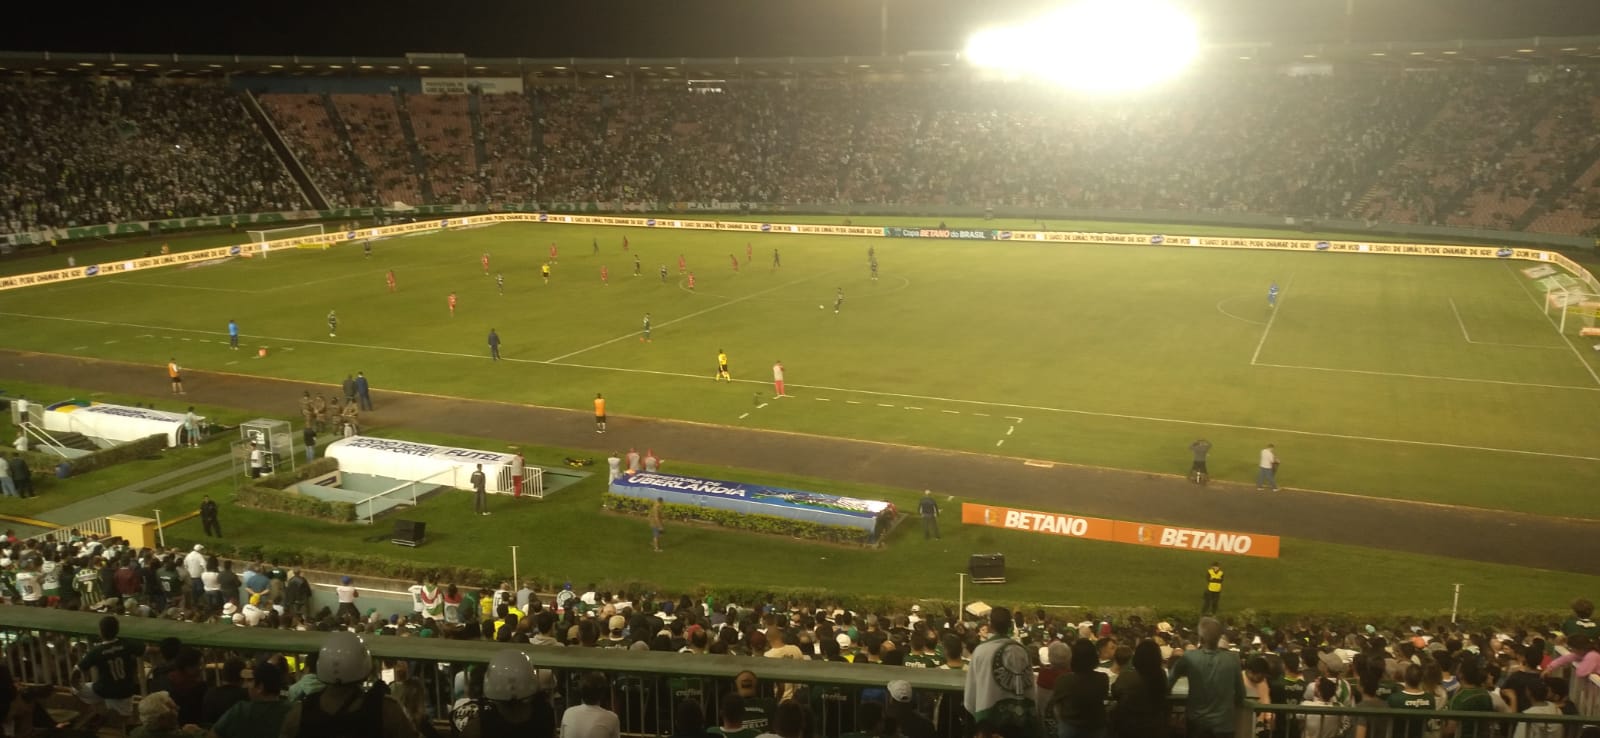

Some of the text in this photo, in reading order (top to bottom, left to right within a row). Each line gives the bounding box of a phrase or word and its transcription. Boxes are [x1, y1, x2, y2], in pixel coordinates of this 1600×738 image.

[903, 229, 919, 237] Copa
[919, 229, 949, 238] BETANO
[960, 231, 986, 239] BRASIL
[445, 449, 502, 462] FUTEL
[628, 476, 746, 497] UBERLANDIA
[1004, 510, 1088, 536] BETANO
[1160, 527, 1252, 554] BETANO
[107, 656, 126, 680] 10
